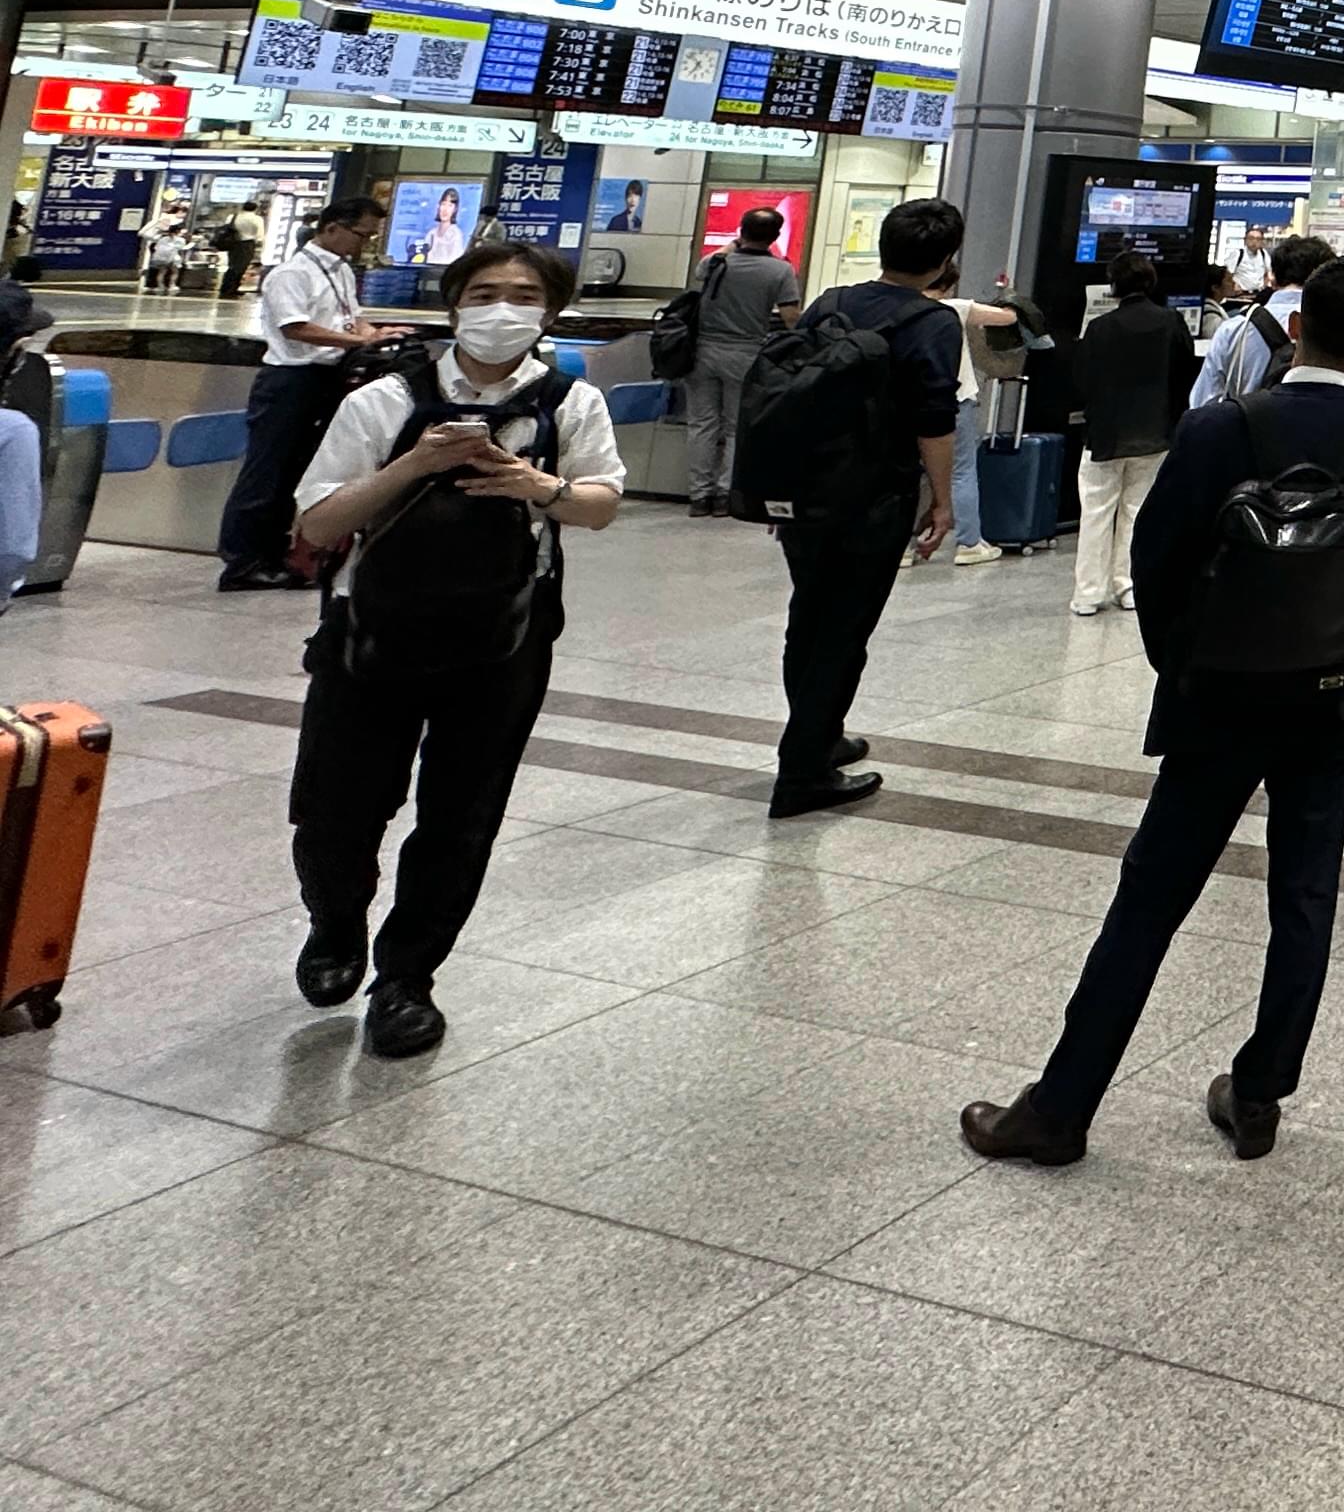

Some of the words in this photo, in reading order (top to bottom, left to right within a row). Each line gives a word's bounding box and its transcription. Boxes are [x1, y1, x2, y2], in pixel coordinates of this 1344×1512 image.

[559, 28, 586, 40] 7:00
[775, 17, 839, 40] Tracks
[845, 29, 890, 48] (South
[894, 38, 953, 57] Entrance
[556, 42, 583, 54] 7:18
[552, 56, 580, 68] 7:30
[549, 70, 575, 82] 7:41
[545, 84, 572, 96] 7:53
[776, 80, 797, 91] 7:34
[769, 105, 791, 116] 8:07
[69, 116, 149, 133] Ekiben
[306, 114, 331, 132] 24
[589, 128, 635, 139] Elevator
